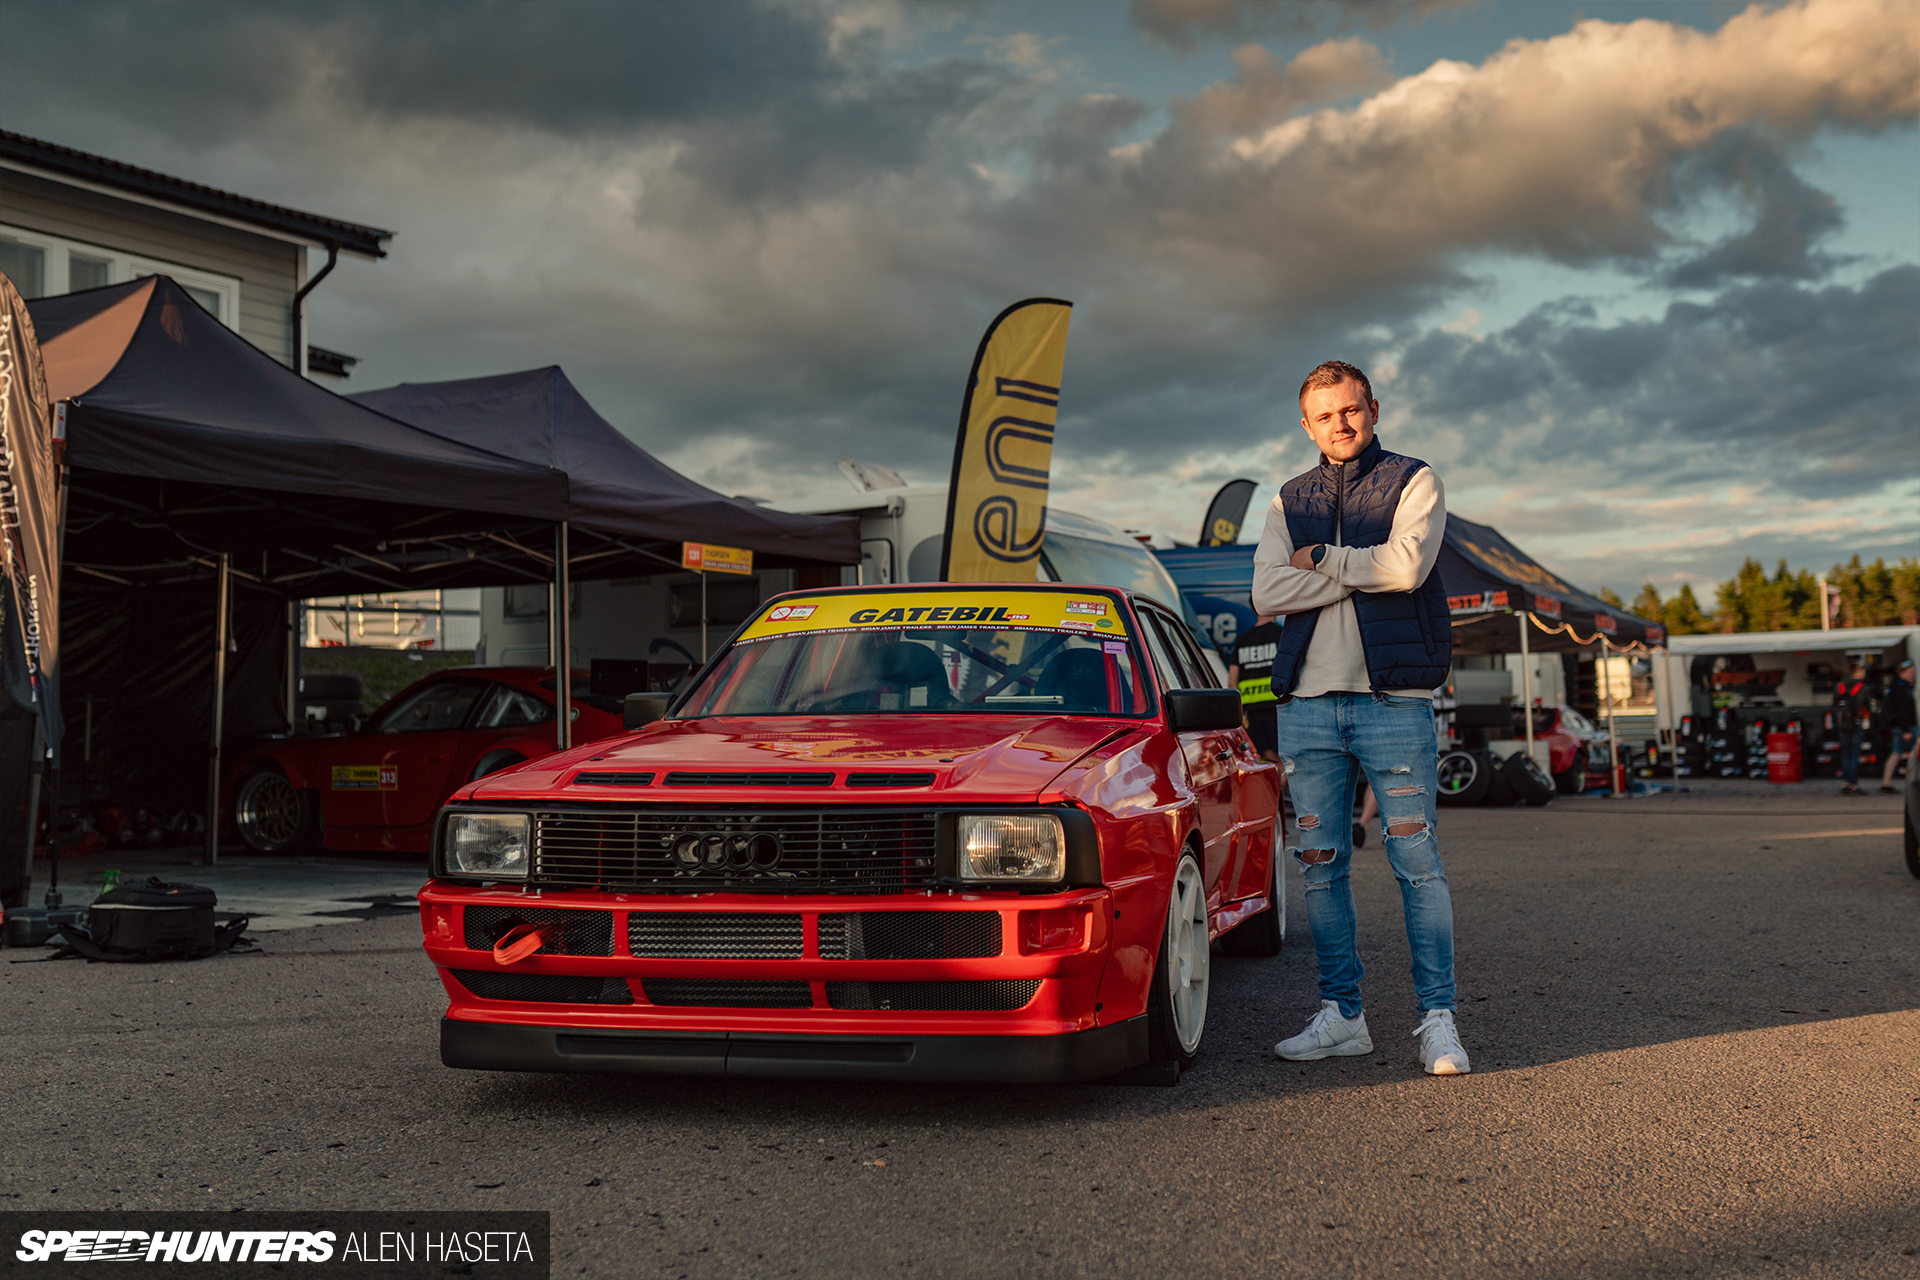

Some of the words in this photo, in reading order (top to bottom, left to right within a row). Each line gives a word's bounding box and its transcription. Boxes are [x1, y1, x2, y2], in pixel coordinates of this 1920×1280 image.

[755, 634, 783, 643] TRAILERS
[1238, 642, 1278, 664] MEDIA
[381, 771, 396, 784] 313
